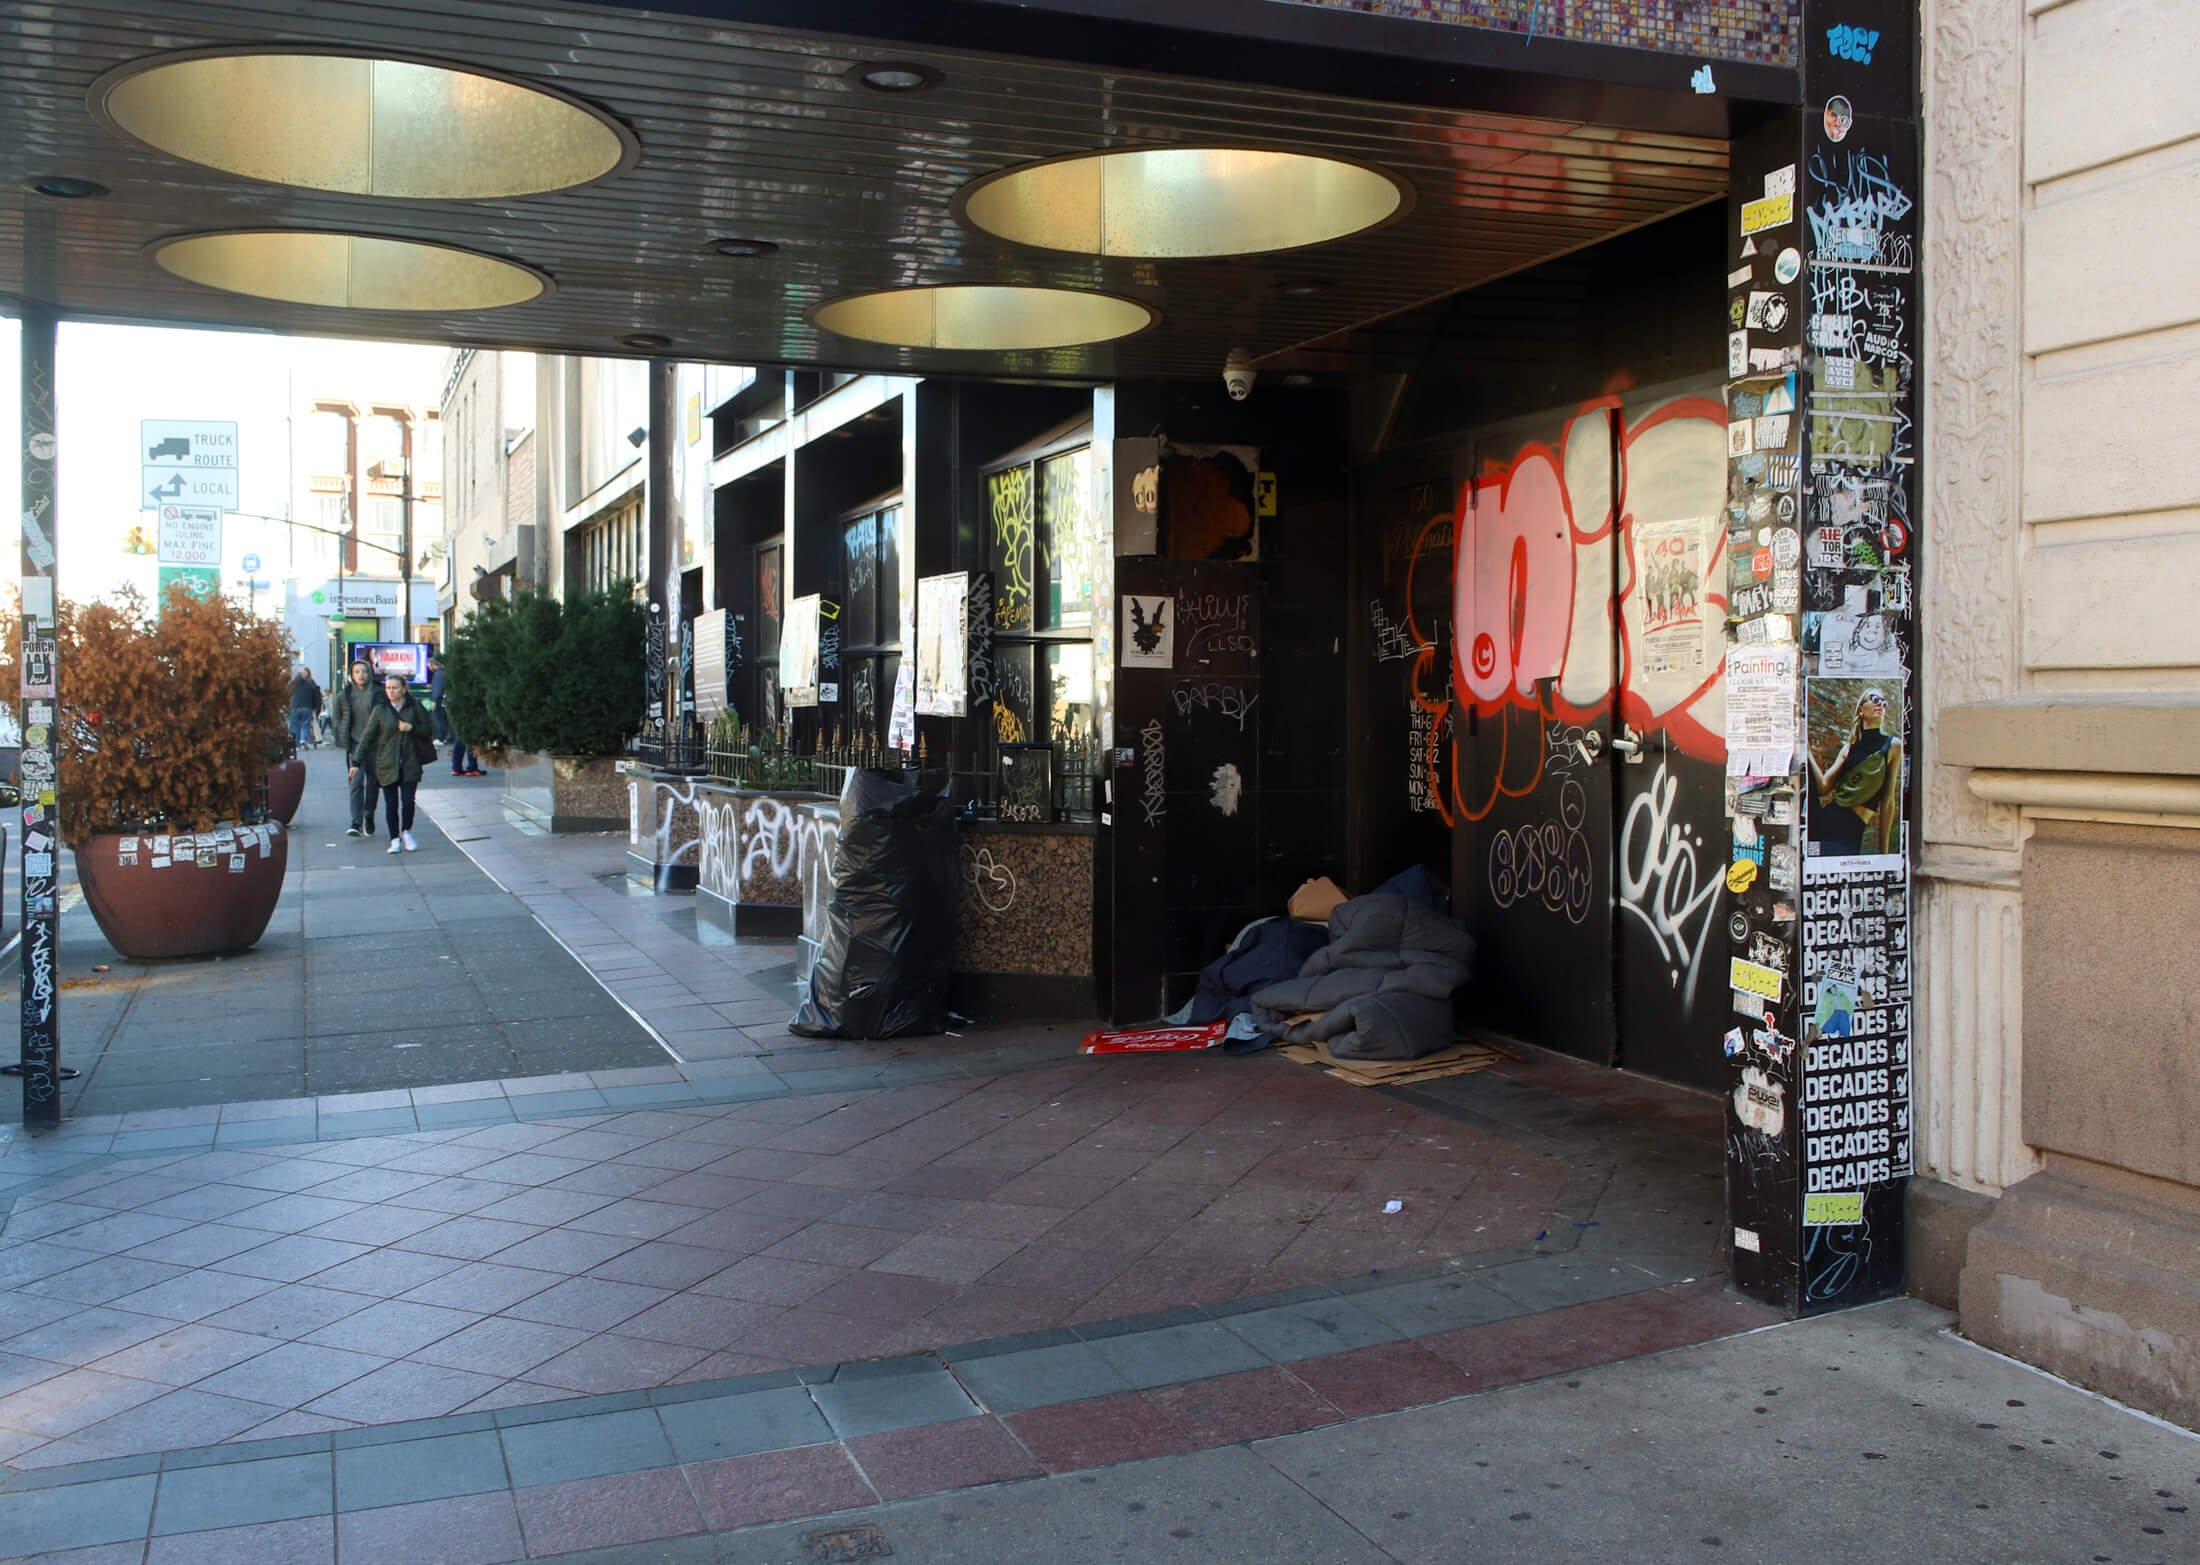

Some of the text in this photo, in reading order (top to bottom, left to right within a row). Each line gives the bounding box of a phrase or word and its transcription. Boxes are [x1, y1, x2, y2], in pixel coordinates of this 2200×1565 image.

[1865, 332, 1899, 350] AUDIO
[1864, 343, 1899, 360] NARCOS
[194, 434, 233, 446] TRUCK
[194, 455, 233, 466] ROUTE
[193, 483, 231, 495] LOCAL
[166, 522, 214, 531] NO ENGINE
[175, 531, 205, 539] IDLING
[164, 541, 216, 551] MAX FINE
[1655, 537, 1686, 556] 40
[22, 641, 55, 653] PORCH
[1733, 660, 1785, 677] Painting
[1410, 731, 1423, 746] FRI
[1410, 748, 1423, 762] SAT
[1410, 764, 1424, 779] SUN
[1409, 781, 1424, 795] MON
[1409, 797, 1424, 812] TUE
[1803, 887, 1886, 916] DECADES
[1803, 916, 1887, 946] DECADES
[1805, 1038, 1888, 1072] DECADES
[1805, 1069, 1889, 1102] DECADES
[1806, 1099, 1889, 1132] DECADES
[1807, 1128, 1890, 1162] DECADES
[1808, 1158, 1890, 1192] DECADES
